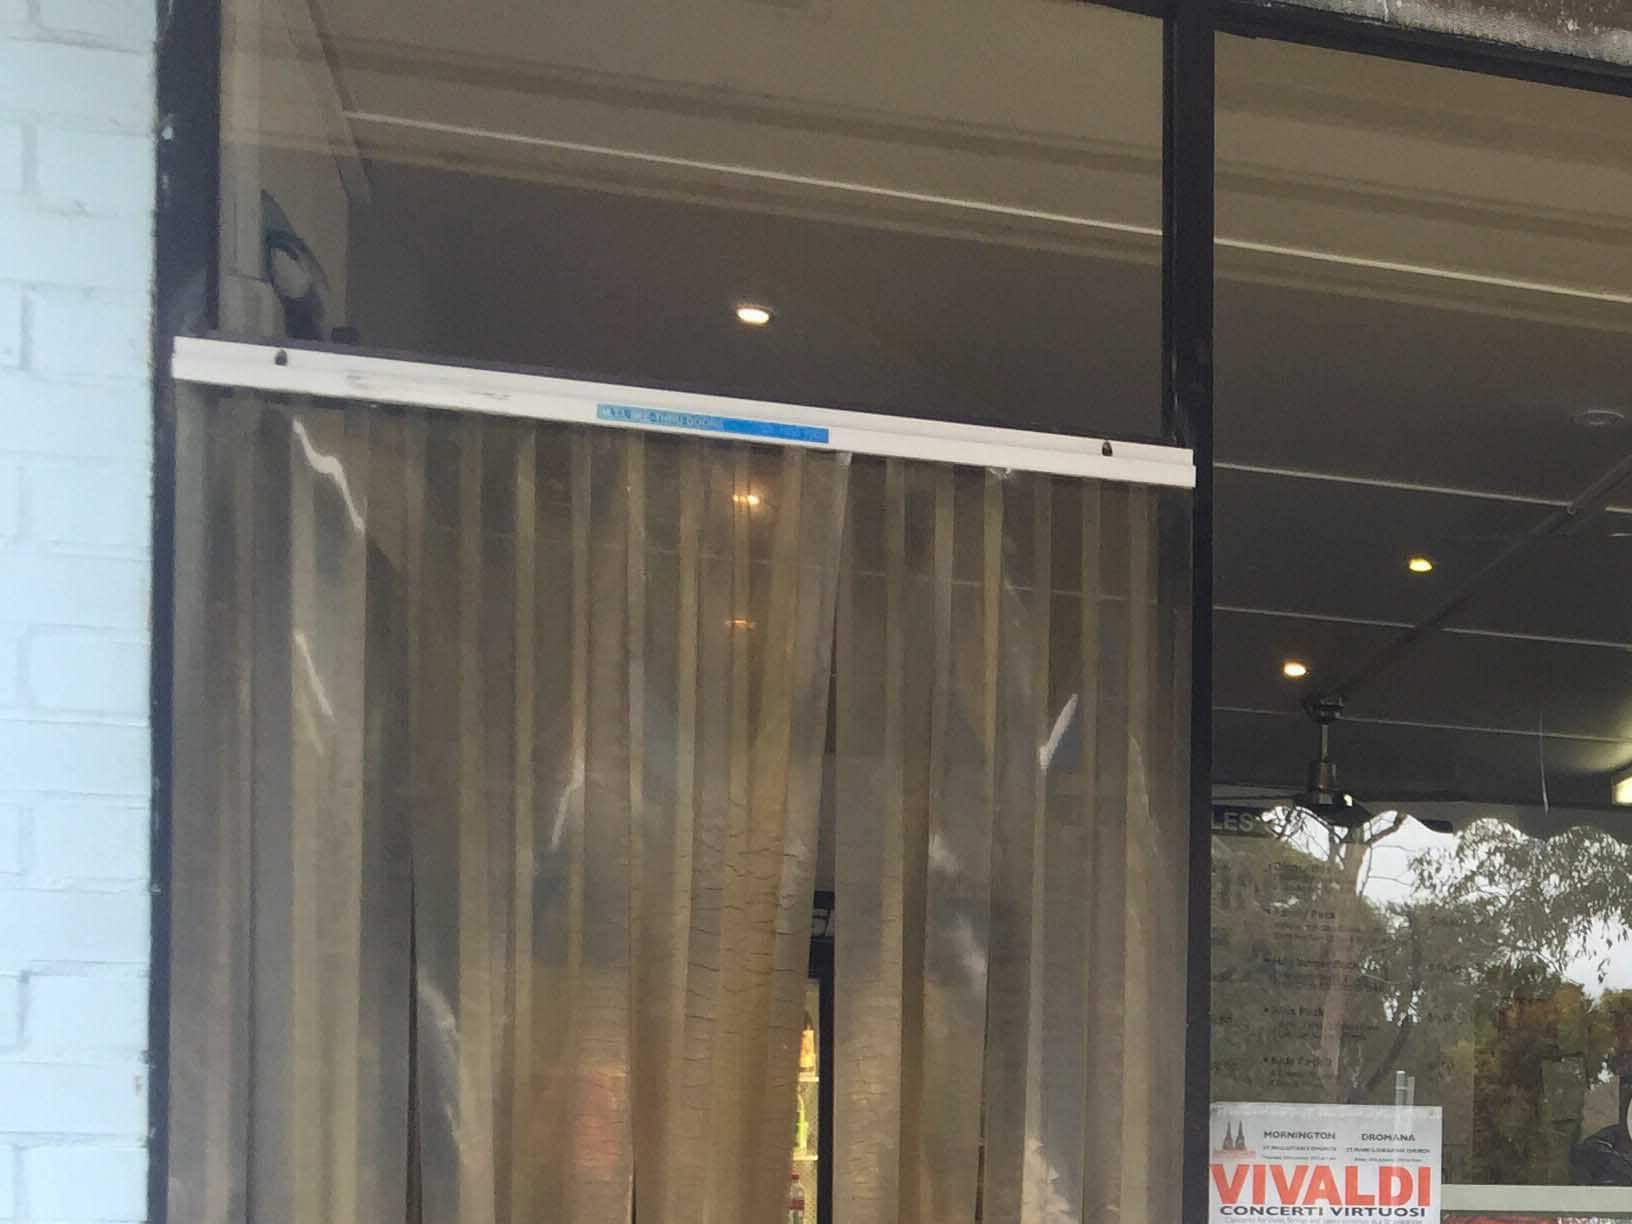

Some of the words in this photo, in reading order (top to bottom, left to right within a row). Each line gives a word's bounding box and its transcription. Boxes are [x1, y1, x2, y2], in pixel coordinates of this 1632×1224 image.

[1263, 1131, 1336, 1141] MORNINGTON
[1361, 1133, 1416, 1142] DROMANA
[1209, 1163, 1432, 1207] VIVALDI
[1220, 1206, 1323, 1216] CONCERTI
[1330, 1207, 1426, 1217] VIRTUOSI
